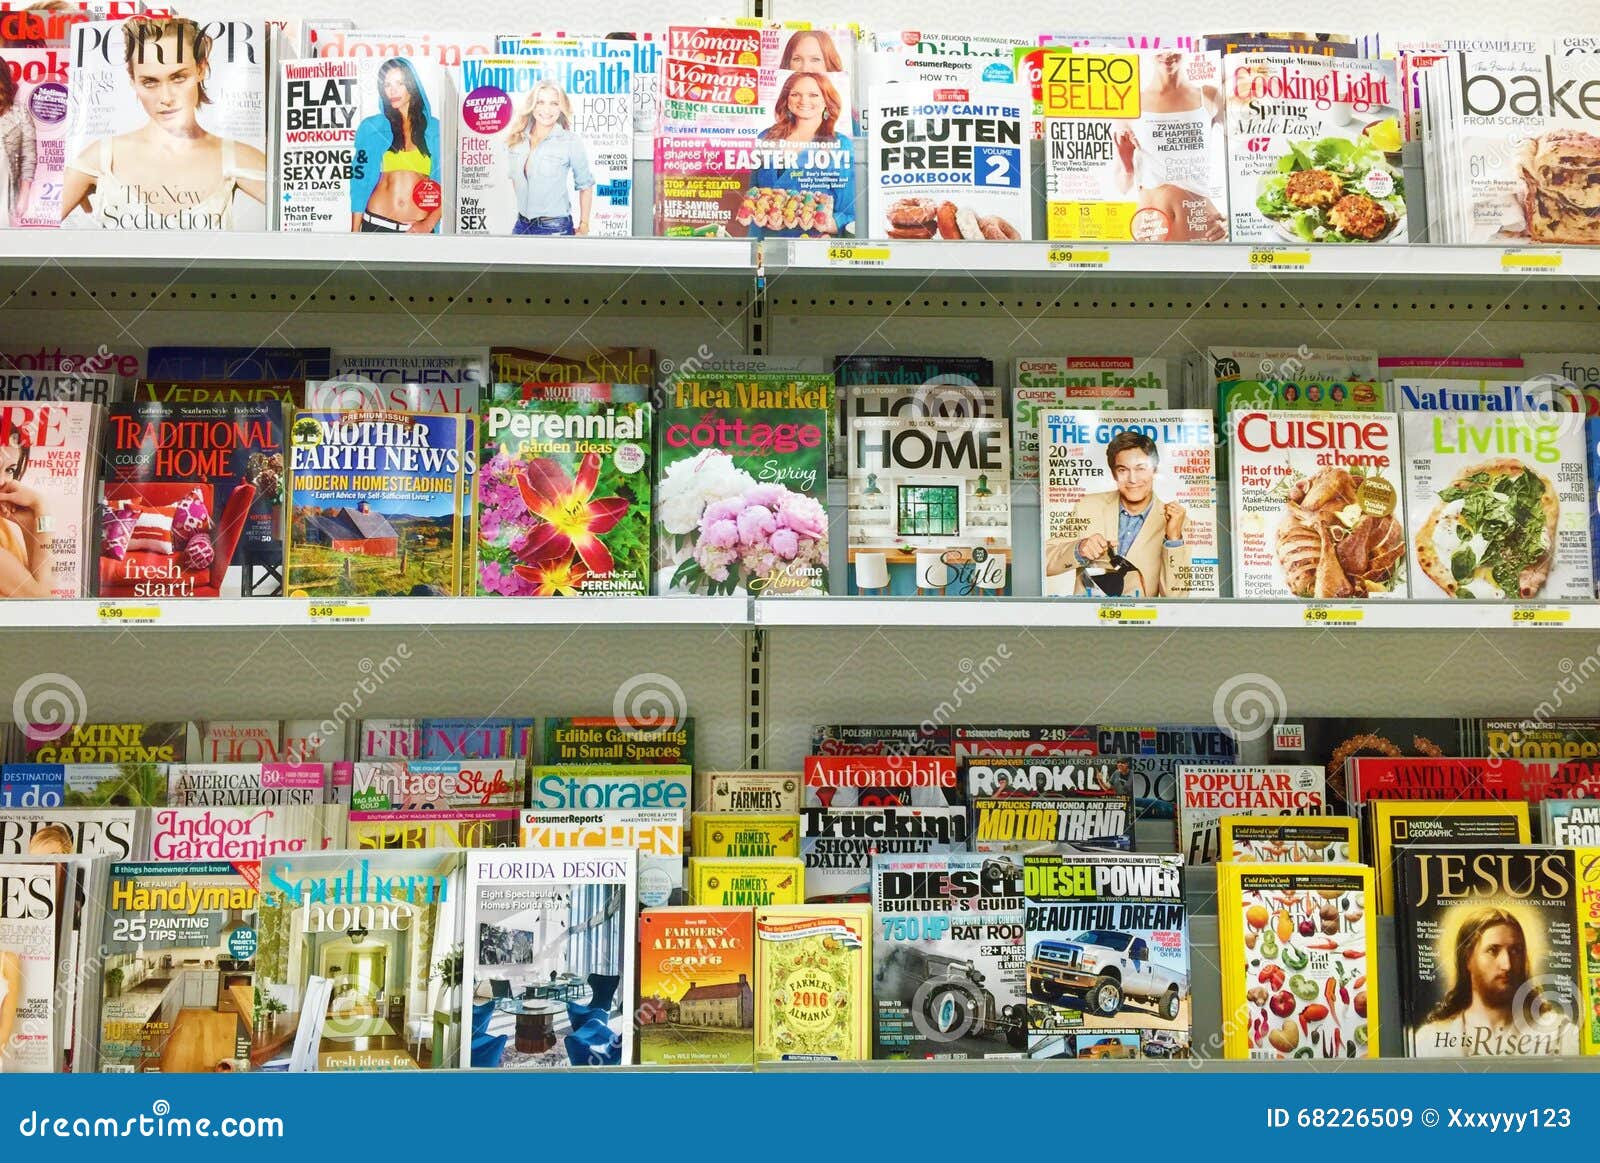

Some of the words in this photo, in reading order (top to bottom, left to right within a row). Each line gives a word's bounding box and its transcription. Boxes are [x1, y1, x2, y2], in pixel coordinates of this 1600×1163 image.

[1049, 58, 1133, 84] ZERO
[287, 79, 357, 108] FLAT
[1234, 66, 1331, 110] Cooking
[1333, 70, 1390, 112] Light
[1049, 85, 1131, 110] BELLY
[479, 112, 497, 120] SKIN
[881, 106, 909, 117] THE
[913, 105, 948, 116] HOW
[952, 106, 985, 116] CAN
[986, 106, 999, 116] IT
[1002, 107, 1020, 118] BE
[1249, 101, 1308, 119] Spring
[287, 107, 357, 131] BELLY
[573, 116, 627, 132] HAPPY
[1464, 116, 1496, 126] FROM
[1498, 116, 1544, 126] SCRATCH
[286, 131, 356, 143] WORKOUTS
[881, 118, 1020, 144] GLUTEN
[1051, 123, 1075, 140] GET
[1077, 123, 1112, 140] BACK
[663, 139, 707, 149] Pioneer
[710, 140, 752, 148] Woman
[755, 140, 776, 148] Ree
[779, 140, 840, 148] Drummond
[1248, 138, 1270, 152] 67
[284, 151, 351, 165] STRONG
[356, 150, 368, 163] &
[982, 148, 1013, 156] VOLUME
[1052, 143, 1063, 159] IN
[1066, 142, 1113, 160] SHAPE!
[725, 151, 801, 170] EASTER
[806, 149, 850, 170] JOY!
[881, 146, 972, 171] FREE
[284, 167, 327, 180] SEXY
[330, 166, 365, 179] ABS
[985, 155, 1011, 185] 2
[881, 172, 972, 185] COOKBOOK
[284, 182, 295, 190] IN
[600, 188, 628, 196] Allergy
[461, 198, 478, 206] Way
[664, 201, 719, 210] LIFE-SAVING
[311, 213, 332, 221] Ever
[664, 210, 731, 219] SUPPLEMENTS!
[461, 216, 486, 230] SEX
[830, 250, 852, 258] 4.50
[1050, 252, 1072, 261] 4.99
[1252, 254, 1273, 263] 9.99
[675, 383, 730, 408] Flea
[734, 383, 829, 409] Market
[489, 408, 642, 439] Perennial
[110, 416, 280, 449] TRADITIONAL
[321, 422, 429, 448] MOTHER
[666, 418, 822, 453] cottage
[1237, 413, 1388, 453] Cuisine
[1433, 417, 1561, 463] Living
[519, 441, 572, 453] Garden
[576, 441, 612, 453] Ideas
[856, 429, 1003, 469] HOME
[1050, 445, 1067, 458] 20
[48, 451, 80, 459] WEAR
[116, 455, 150, 465] COLOR
[290, 446, 383, 470] EARTH
[384, 449, 459, 473] NEWS
[27, 460, 53, 468] THIS
[155, 450, 234, 477] HOME
[1049, 459, 1076, 467] WAYS
[1079, 459, 1092, 467] TO
[1561, 463, 1582, 473] FRESH
[759, 460, 817, 491] Spring
[1058, 468, 1104, 476] FLATTER
[1174, 466, 1210, 474] ENERGY
[1241, 465, 1257, 475] Hit
[1260, 465, 1273, 475] of
[1275, 466, 1292, 475] the
[295, 475, 348, 490] MODERN
[353, 477, 452, 492] HOMESTEADING
[1241, 475, 1271, 488] Party
[1558, 473, 1583, 483] STARTS
[1242, 488, 1267, 496] Simple
[1571, 484, 1584, 492] FOR
[1559, 493, 1584, 502] SPRING
[1242, 504, 1281, 513] Appetizers
[123, 559, 182, 579] fresh
[134, 577, 195, 597] start!
[581, 581, 644, 590] PERENNIAL
[1245, 581, 1272, 589] Recipes
[100, 609, 122, 617] 4.99
[310, 607, 332, 616] 3.49
[1100, 610, 1121, 619] 4.99
[1306, 611, 1327, 620] 4.99
[1514, 612, 1534, 620] 2.99
[71, 725, 142, 747] MINI
[556, 730, 601, 742] Edible
[606, 729, 687, 744] Gardening
[1277, 737, 1301, 747] LIFE
[562, 745, 576, 758] In
[580, 744, 627, 758] Small
[630, 745, 680, 760] Spaces
[4, 773, 62, 781] DESTINATION
[808, 760, 956, 788] Automobile
[178, 775, 260, 789] AMERICAN
[1184, 775, 1292, 790] POPULAR
[539, 775, 687, 808] Storage
[1185, 792, 1322, 808] MECHANICS
[157, 810, 274, 836] Indoor
[1410, 829, 1452, 838] GEOGRAPHIC
[815, 840, 868, 854] SHOW
[877, 840, 932, 854] BUILT
[806, 854, 865, 868] DAILY
[478, 863, 555, 879] FLORIDA
[563, 861, 627, 878] DESIGN
[1415, 855, 1569, 907] JESUS
[150, 919, 208, 929] PAINTING
[1027, 906, 1116, 931] BEAUTIFUL
[1119, 904, 1182, 930] DREAM
[113, 919, 146, 941] 25
[149, 930, 176, 940] TIPS
[237, 931, 251, 939] 120
[653, 938, 741, 950] ALMANAC
[1310, 952, 1330, 962] Eat
[793, 992, 828, 1007] 2016
